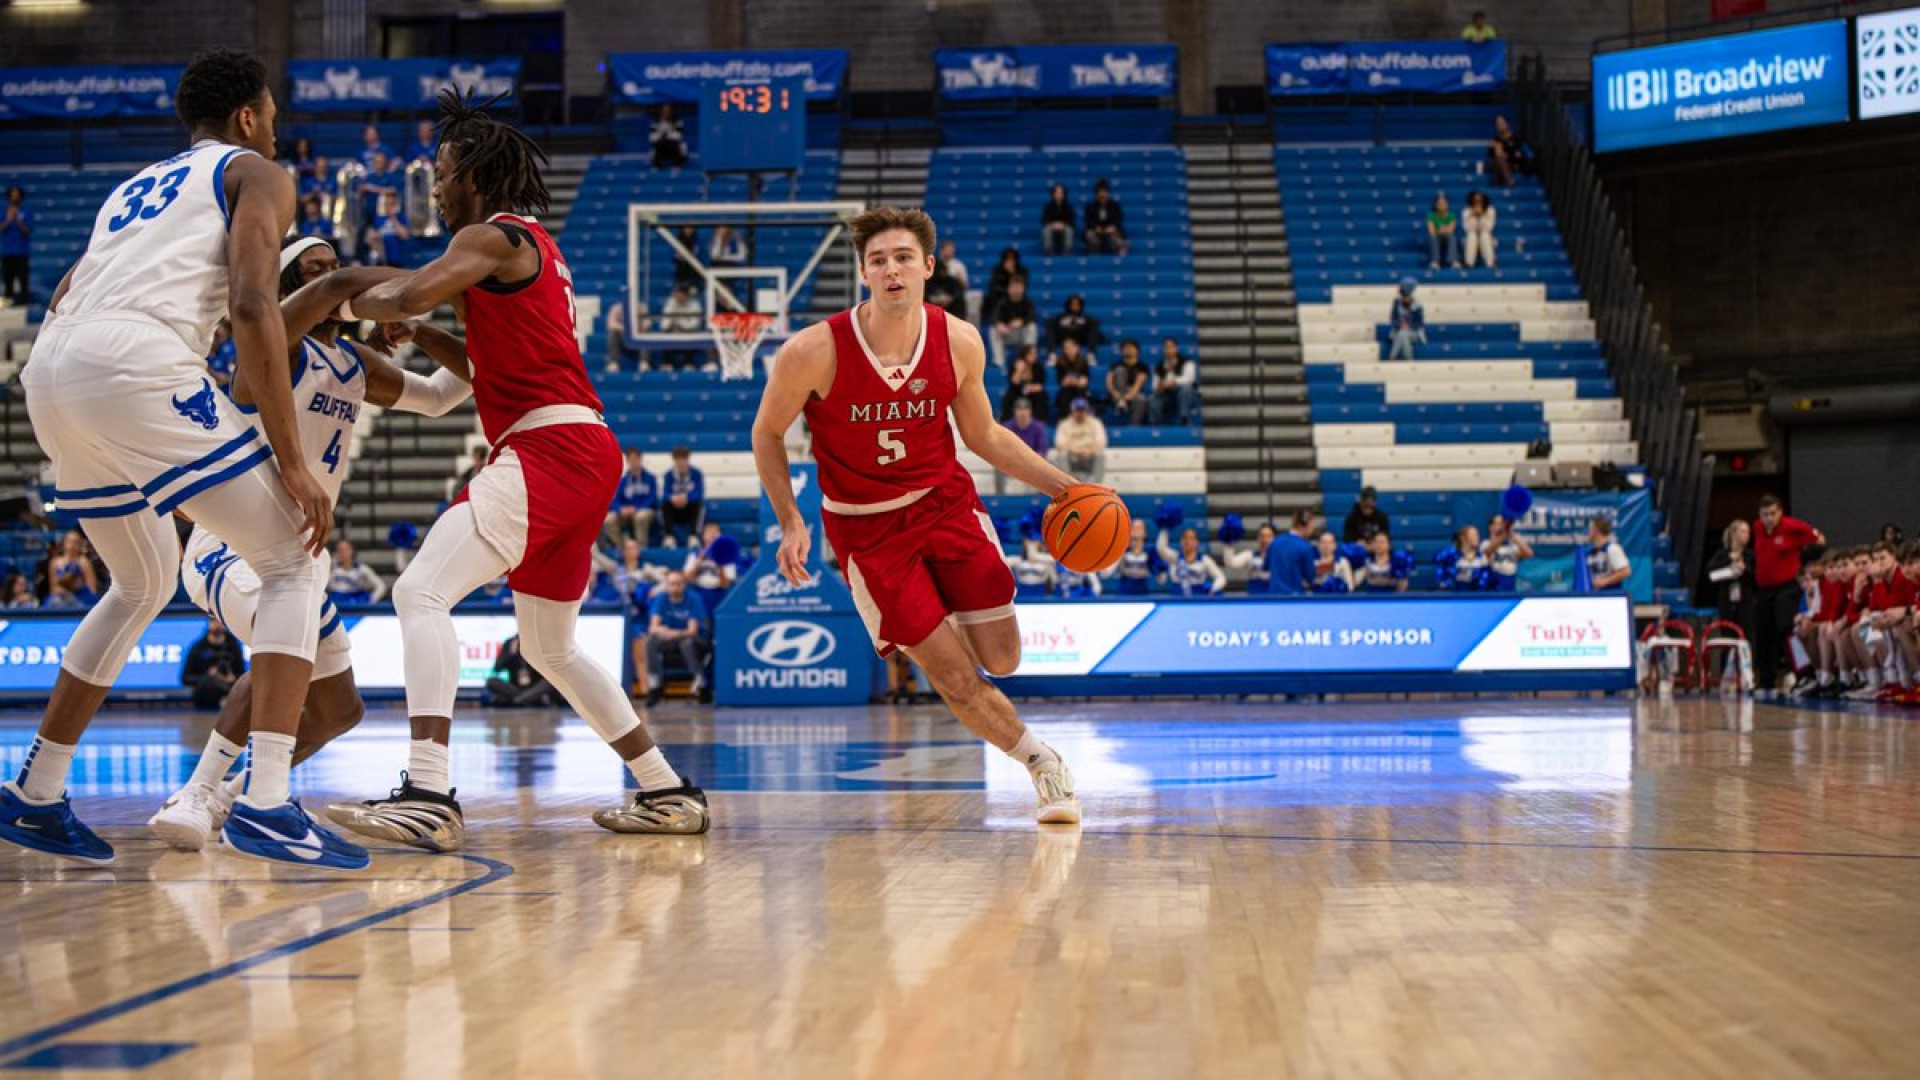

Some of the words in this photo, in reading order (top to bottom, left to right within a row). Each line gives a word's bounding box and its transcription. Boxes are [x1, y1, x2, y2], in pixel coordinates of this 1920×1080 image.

[645, 60, 813, 79] audenbuffalo.com
[1301, 51, 1471, 70] audenbuffalo.com
[1674, 54, 1827, 99] Broadview
[720, 86, 789, 113] 19:31
[1674, 101, 1723, 121] Federal
[1724, 97, 1764, 116] Credit
[1765, 91, 1805, 110] Union
[108, 165, 191, 232] 33
[307, 391, 360, 424] BUFFAL
[849, 399, 937, 422] MIAMI
[322, 429, 342, 474] 4
[877, 428, 907, 466] 5
[1020, 625, 1076, 651] ully's
[1187, 630, 1270, 648] TODAY'S
[1277, 629, 1332, 647] GAME
[1340, 627, 1433, 646] SPONSOR
[1526, 620, 1603, 645] Tully's
[0, 646, 65, 664] TODA
[128, 644, 182, 663] AME
[735, 668, 848, 688] HYUNDAI
